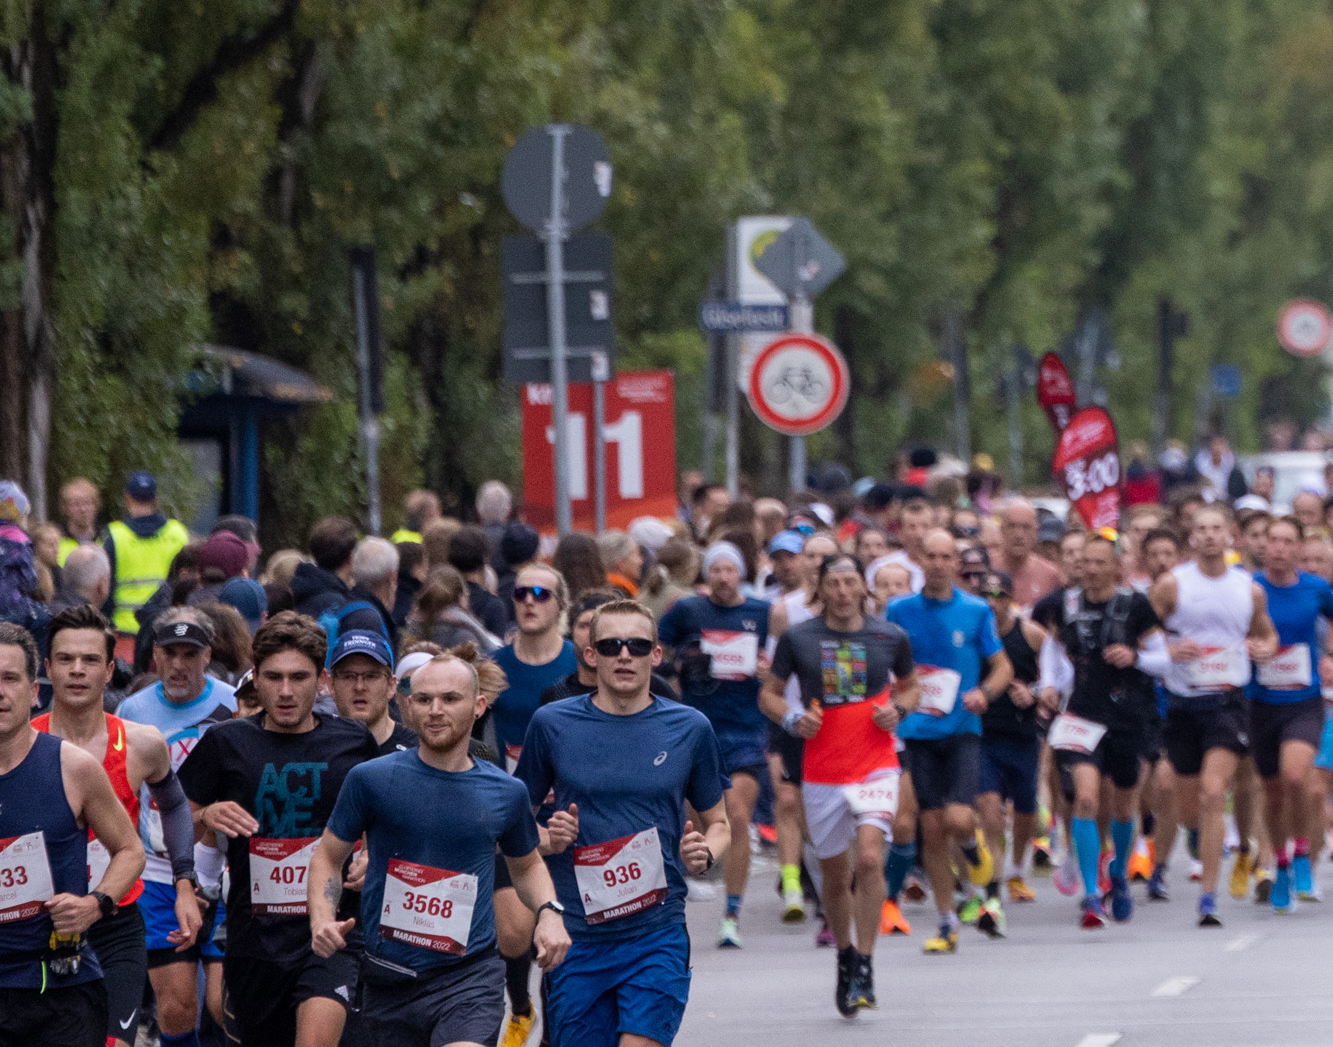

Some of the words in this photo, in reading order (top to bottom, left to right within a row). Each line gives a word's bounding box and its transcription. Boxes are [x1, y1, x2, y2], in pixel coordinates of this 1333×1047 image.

[545, 410, 643, 500] 11
[255, 762, 329, 802] ACT
[0, 865, 28, 888] 33
[269, 866, 308, 885] 407
[603, 861, 642, 887] 936
[384, 904, 391, 914] A
[402, 891, 453, 919] 3568
[584, 893, 592, 903] A
[267, 905, 307, 914] MARATHON
[603, 901, 642, 919] MARATHON
[393, 929, 432, 947] MARATHON
[432, 940, 451, 951] 2022
